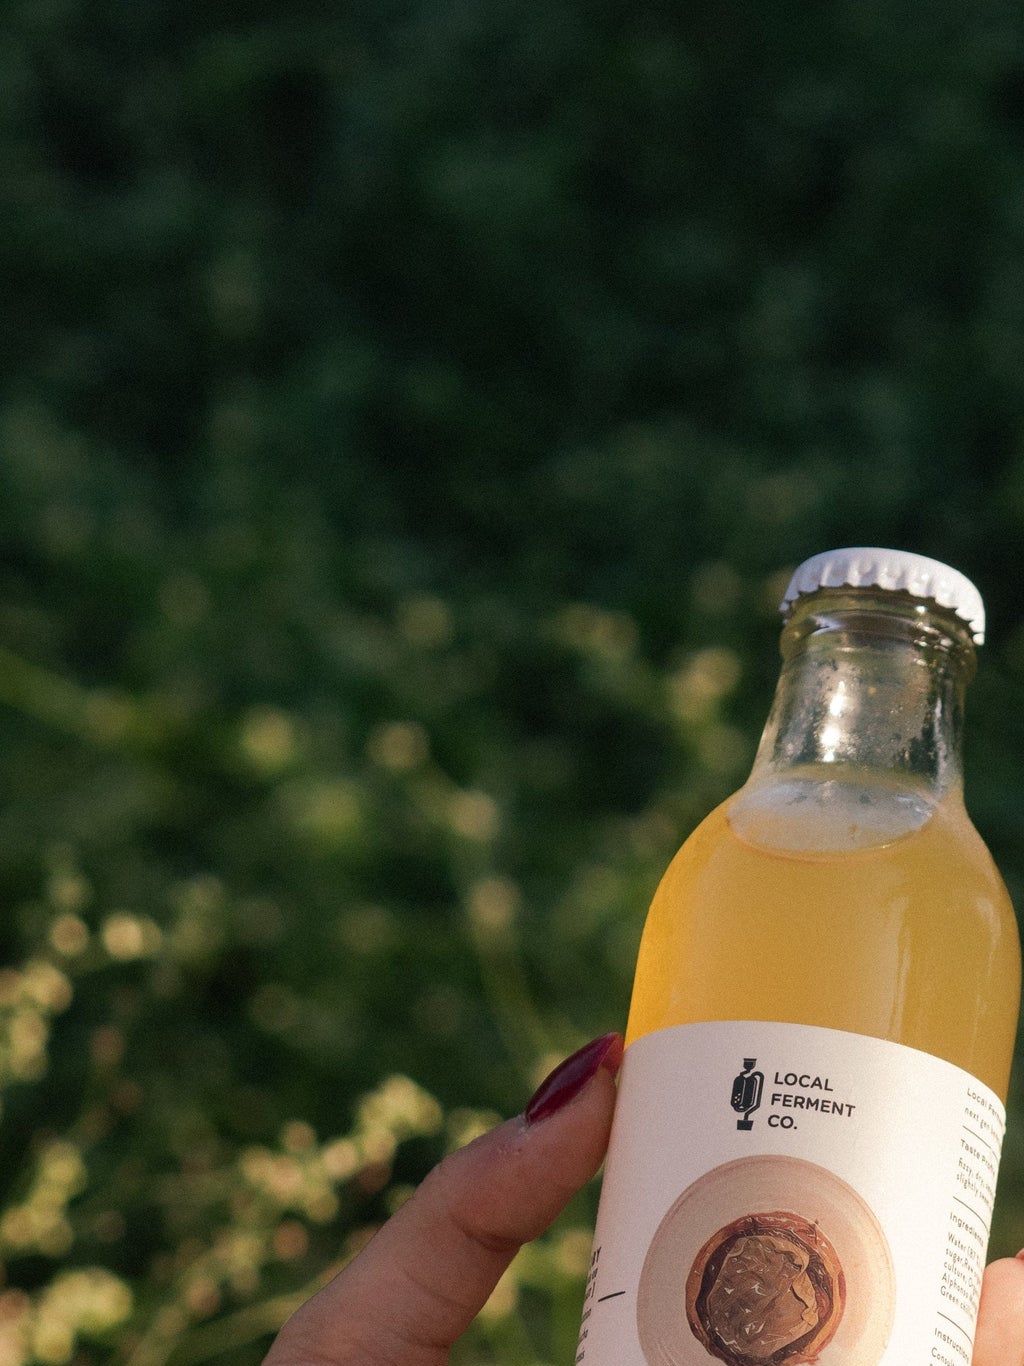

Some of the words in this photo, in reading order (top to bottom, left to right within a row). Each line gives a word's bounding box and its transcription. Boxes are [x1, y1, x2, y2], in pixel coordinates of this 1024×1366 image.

[774, 1072, 834, 1092] LOCAL
[771, 1093, 856, 1117] FERMENT
[768, 1115, 798, 1130] CO.
[961, 1139, 980, 1159] Taste
[948, 1232, 966, 1250] Water
[940, 1286, 959, 1304] Green
